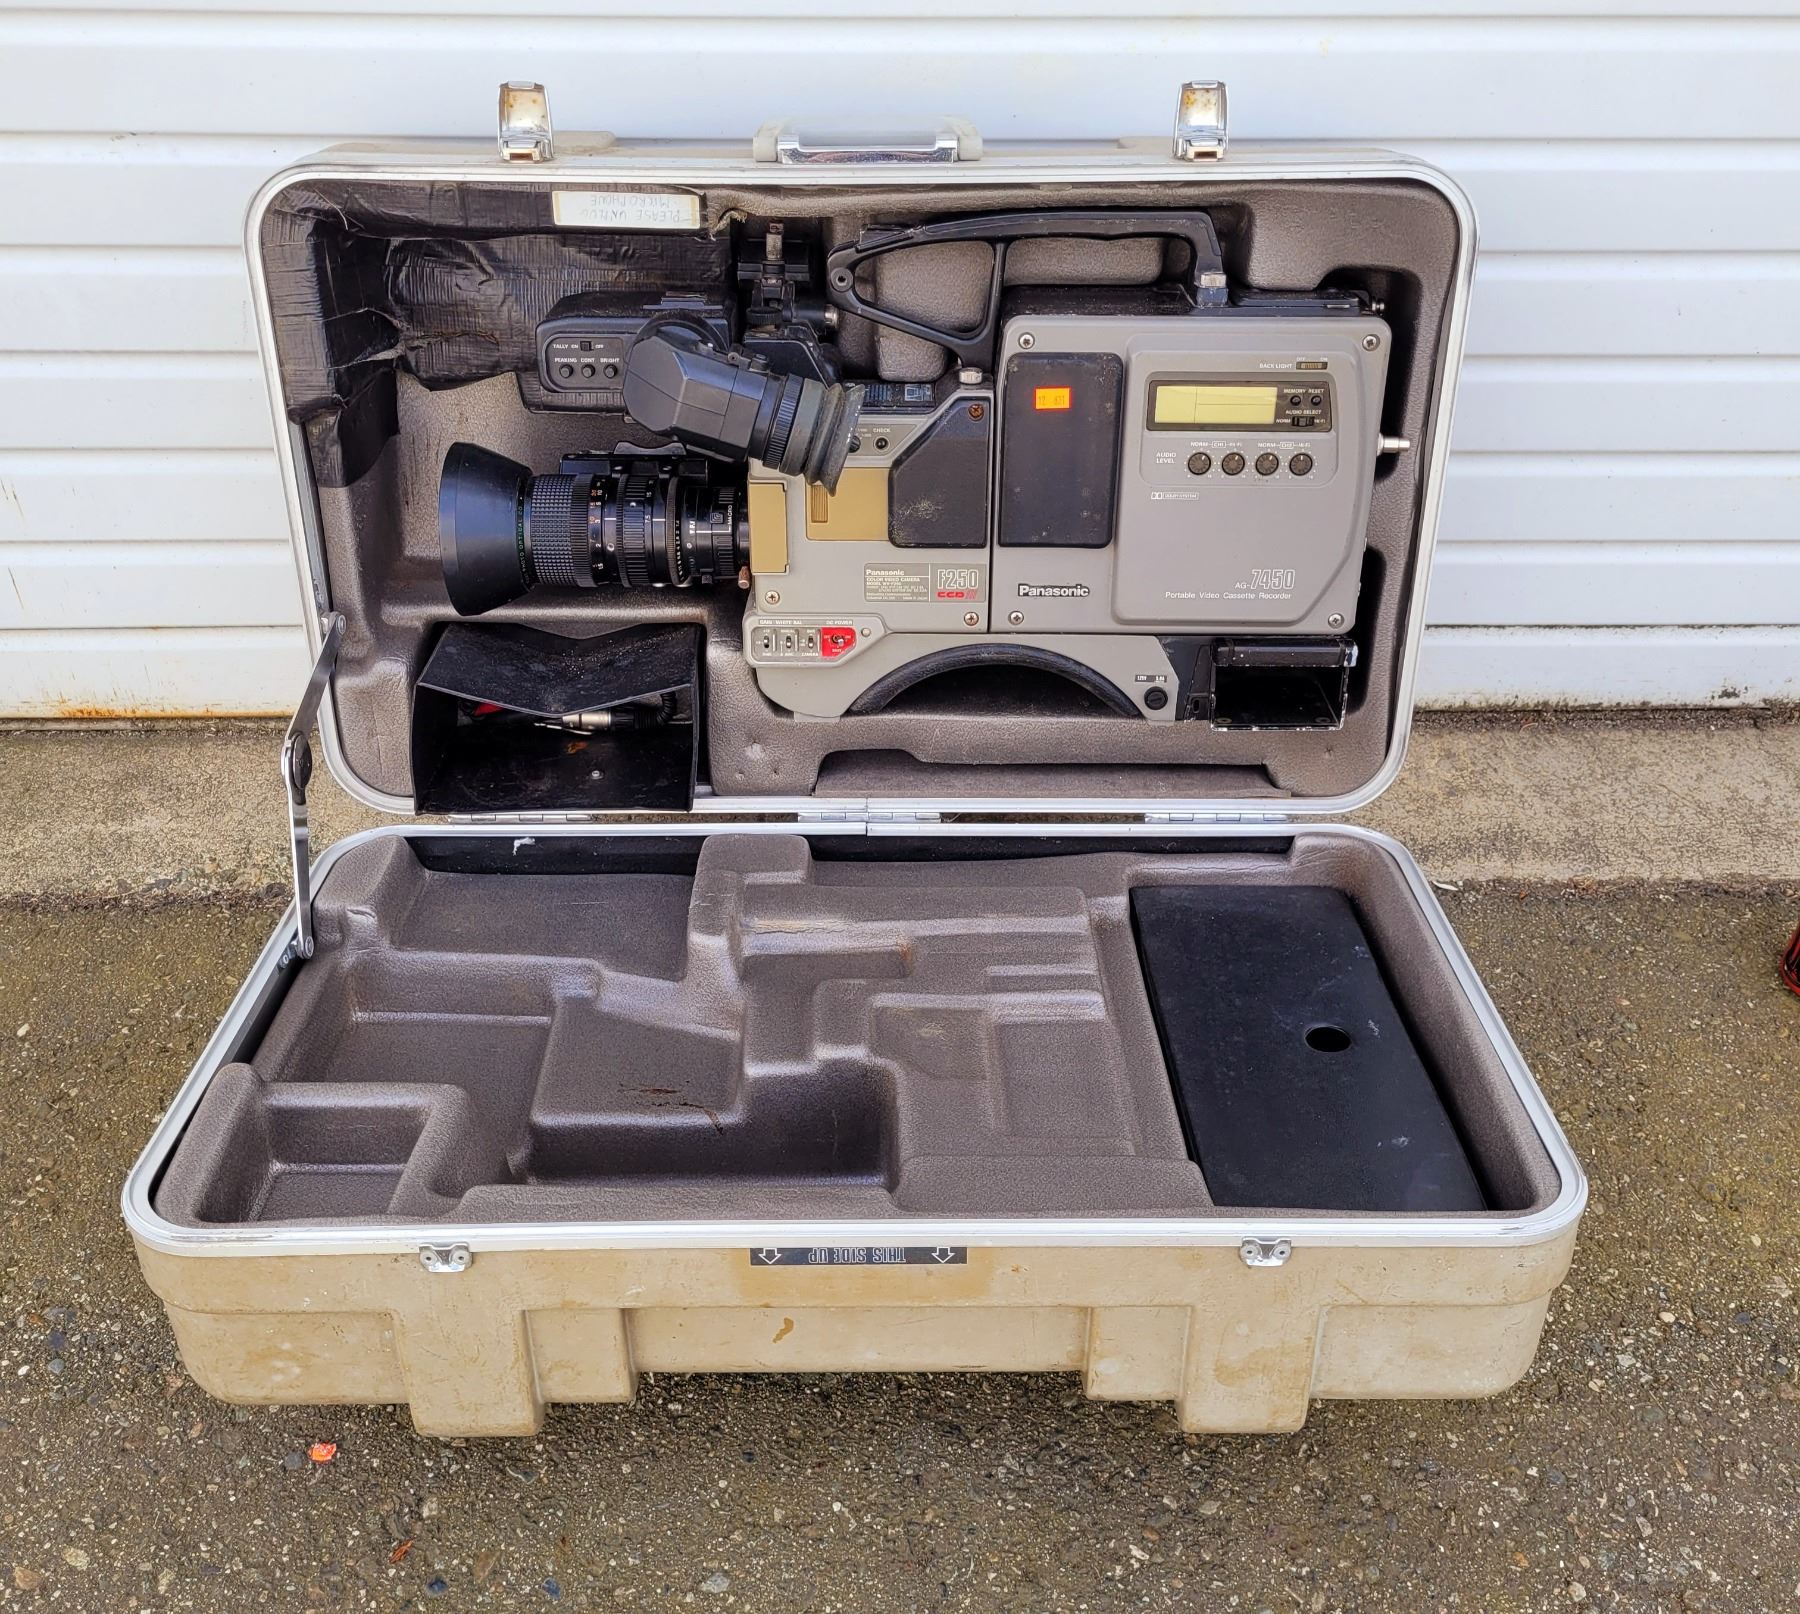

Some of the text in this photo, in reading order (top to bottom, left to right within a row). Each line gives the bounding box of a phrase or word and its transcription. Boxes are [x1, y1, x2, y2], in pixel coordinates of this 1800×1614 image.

[634, 209, 681, 223] PLEASE
[937, 568, 979, 590] F250
[1019, 583, 1090, 598] Panasonic
[1165, 591, 1292, 599] Portable Video Cassette Recorder
[808, 1247, 906, 1264] THIS SIDE UP
